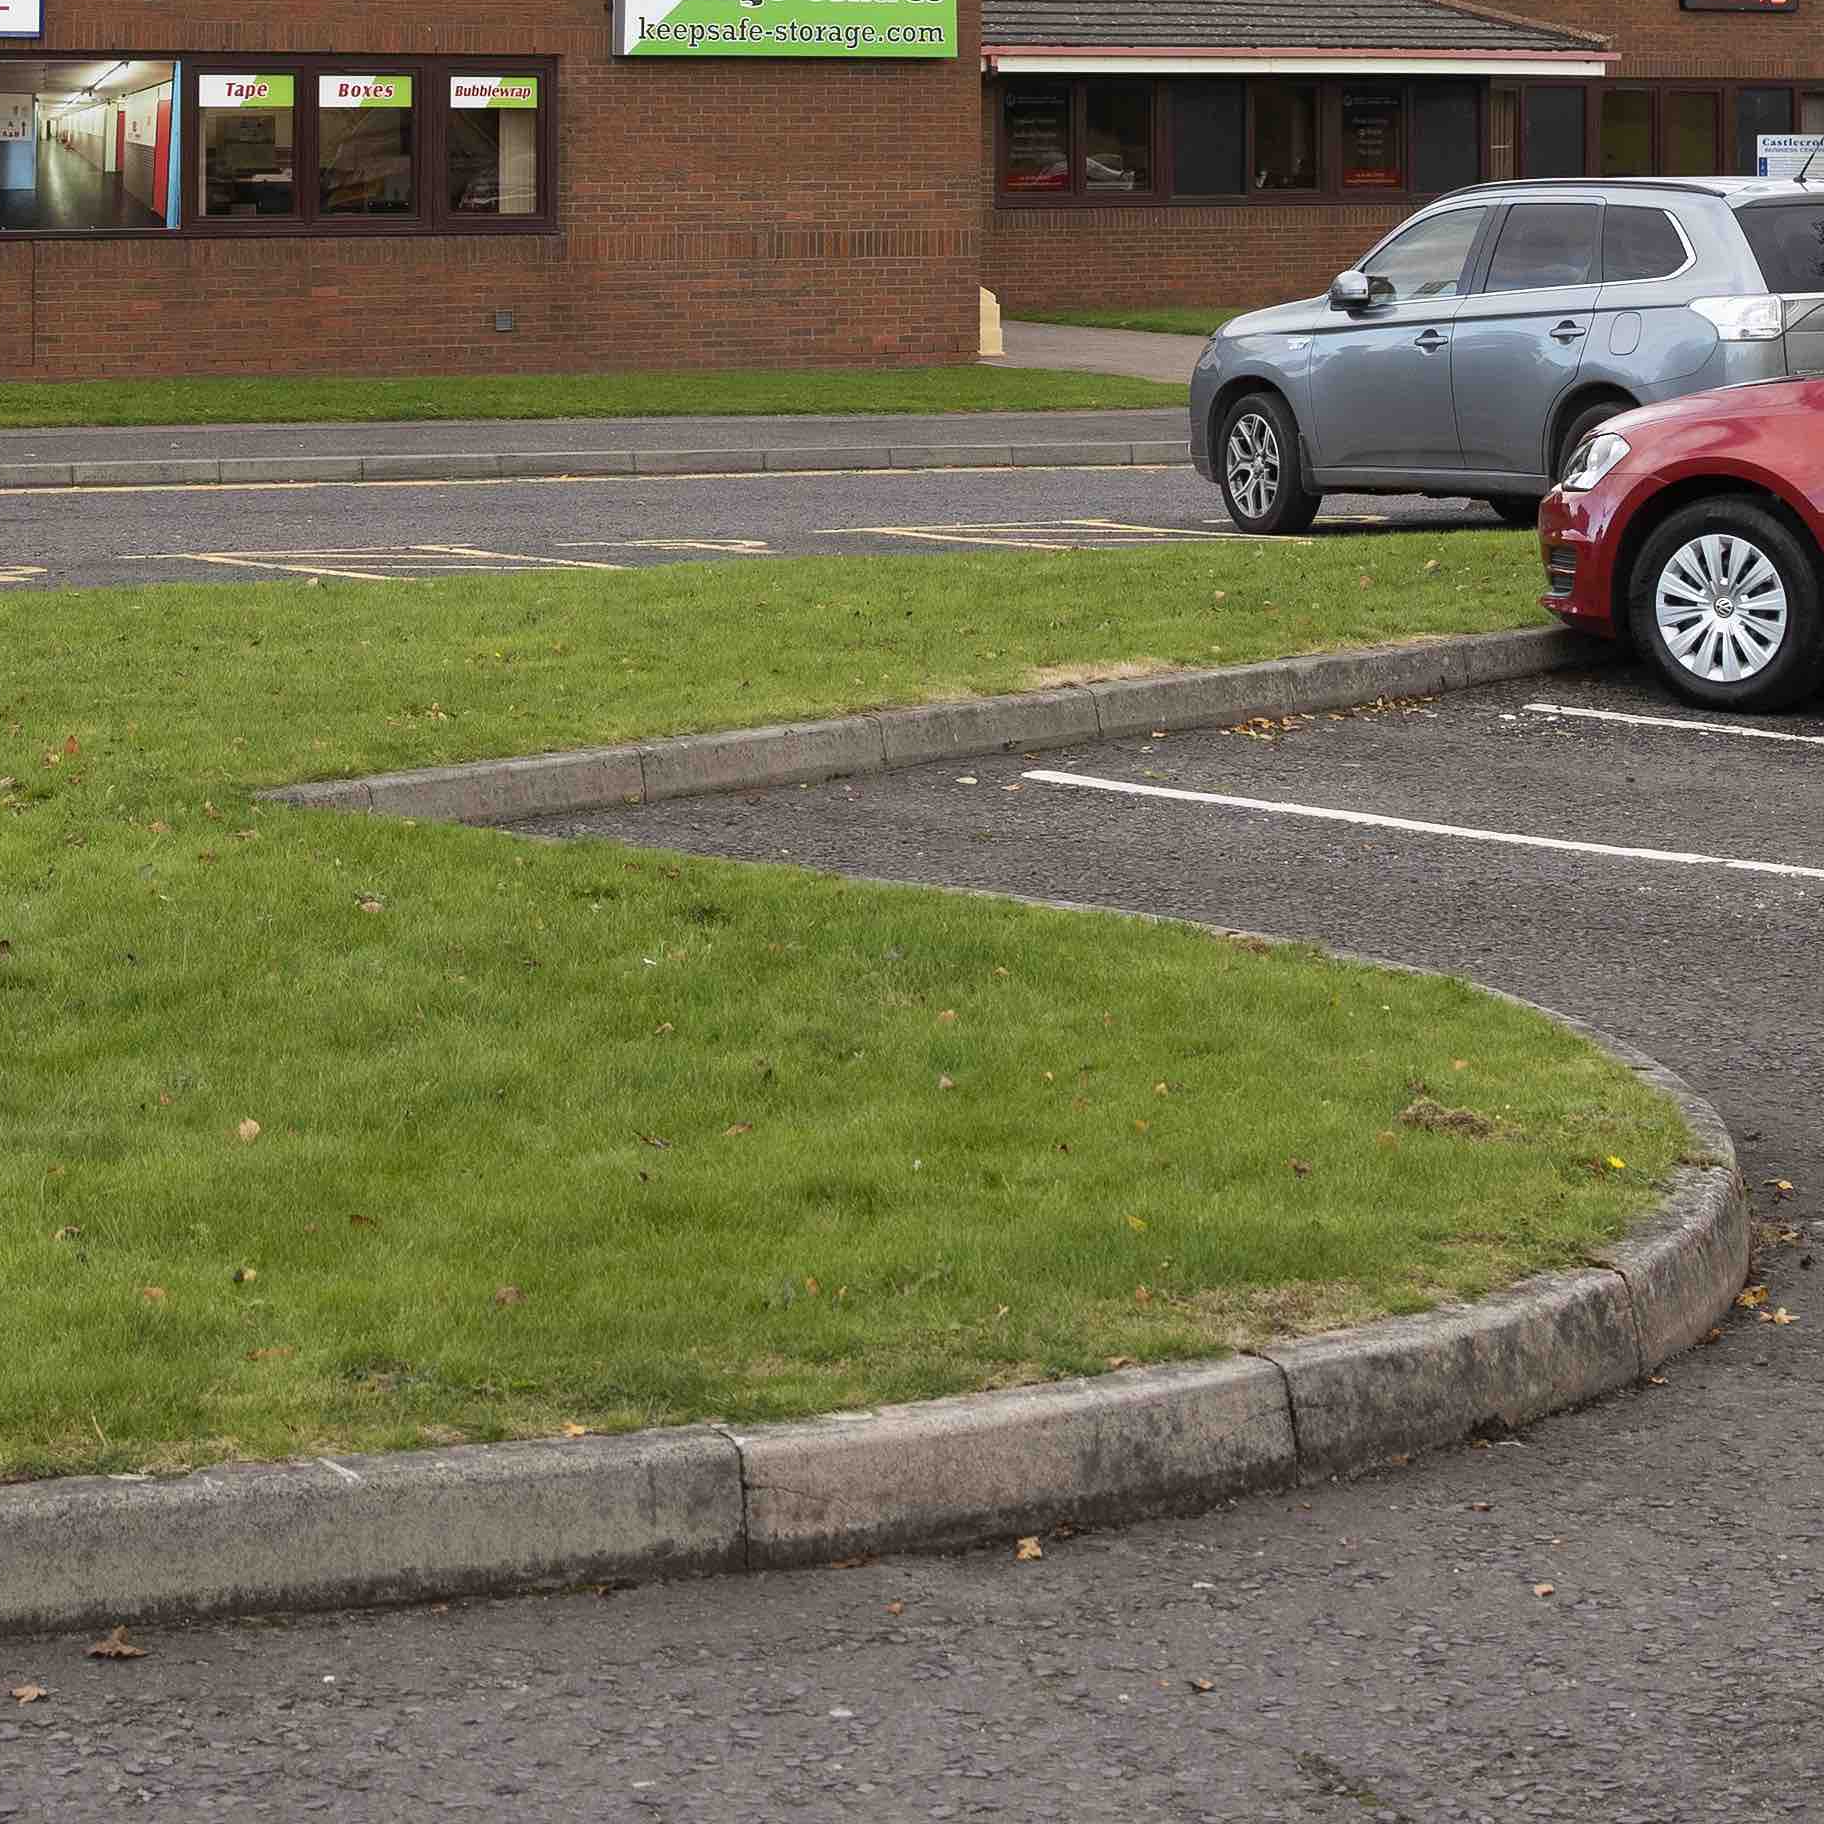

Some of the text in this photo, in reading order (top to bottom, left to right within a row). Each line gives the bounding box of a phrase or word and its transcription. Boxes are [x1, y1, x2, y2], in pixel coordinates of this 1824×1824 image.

[638, 17, 944, 49] keepsafe-storage.com
[225, 82, 269, 99] Tape
[338, 82, 394, 99] Boxes
[454, 85, 532, 99] Bubblewrap
